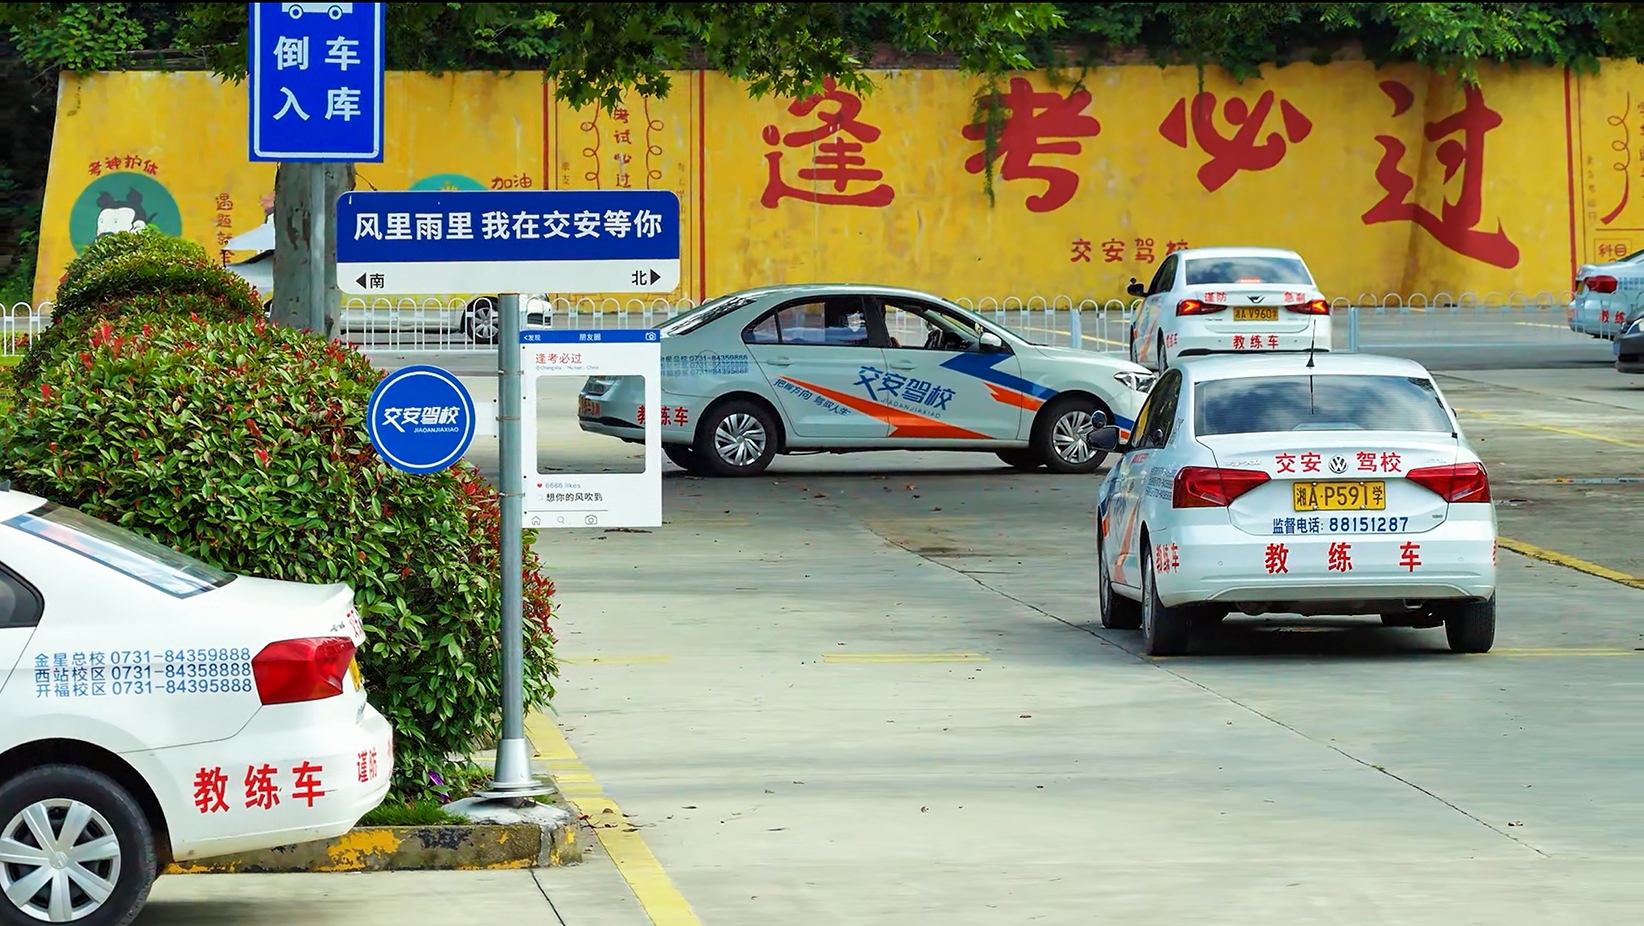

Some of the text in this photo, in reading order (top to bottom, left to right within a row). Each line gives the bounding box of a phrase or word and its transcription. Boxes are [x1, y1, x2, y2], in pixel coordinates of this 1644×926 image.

[273, 36, 361, 71] 倒车
[273, 87, 361, 121] 入库
[491, 172, 533, 190] 加油
[761, 77, 1521, 269] 逢考必过
[353, 209, 663, 241] 风里雨里 我在交安等你
[1598, 243, 1627, 258] 科目
[369, 272, 385, 289] 南
[631, 270, 648, 286] 北
[579, 333, 602, 341] 朋友圈
[1232, 335, 1279, 350] 教练车
[535, 353, 583, 364] 逢考必过
[852, 365, 957, 411] 交安驾校
[381, 405, 461, 433] 交安驾校
[1275, 452, 1322, 473] 交安
[1356, 451, 1402, 473] 驾校
[546, 492, 603, 502] 想你的风吹到
[1272, 517, 1409, 534] 监督电话: 88151287
[1264, 541, 1422, 575] 教练车
[34, 647, 250, 668] 金星总校 0731-84359888
[35, 662, 251, 684] 西站校区 0731-84358888
[36, 678, 252, 698] 开福校区 0731-84395888
[193, 760, 326, 813] 教练车
